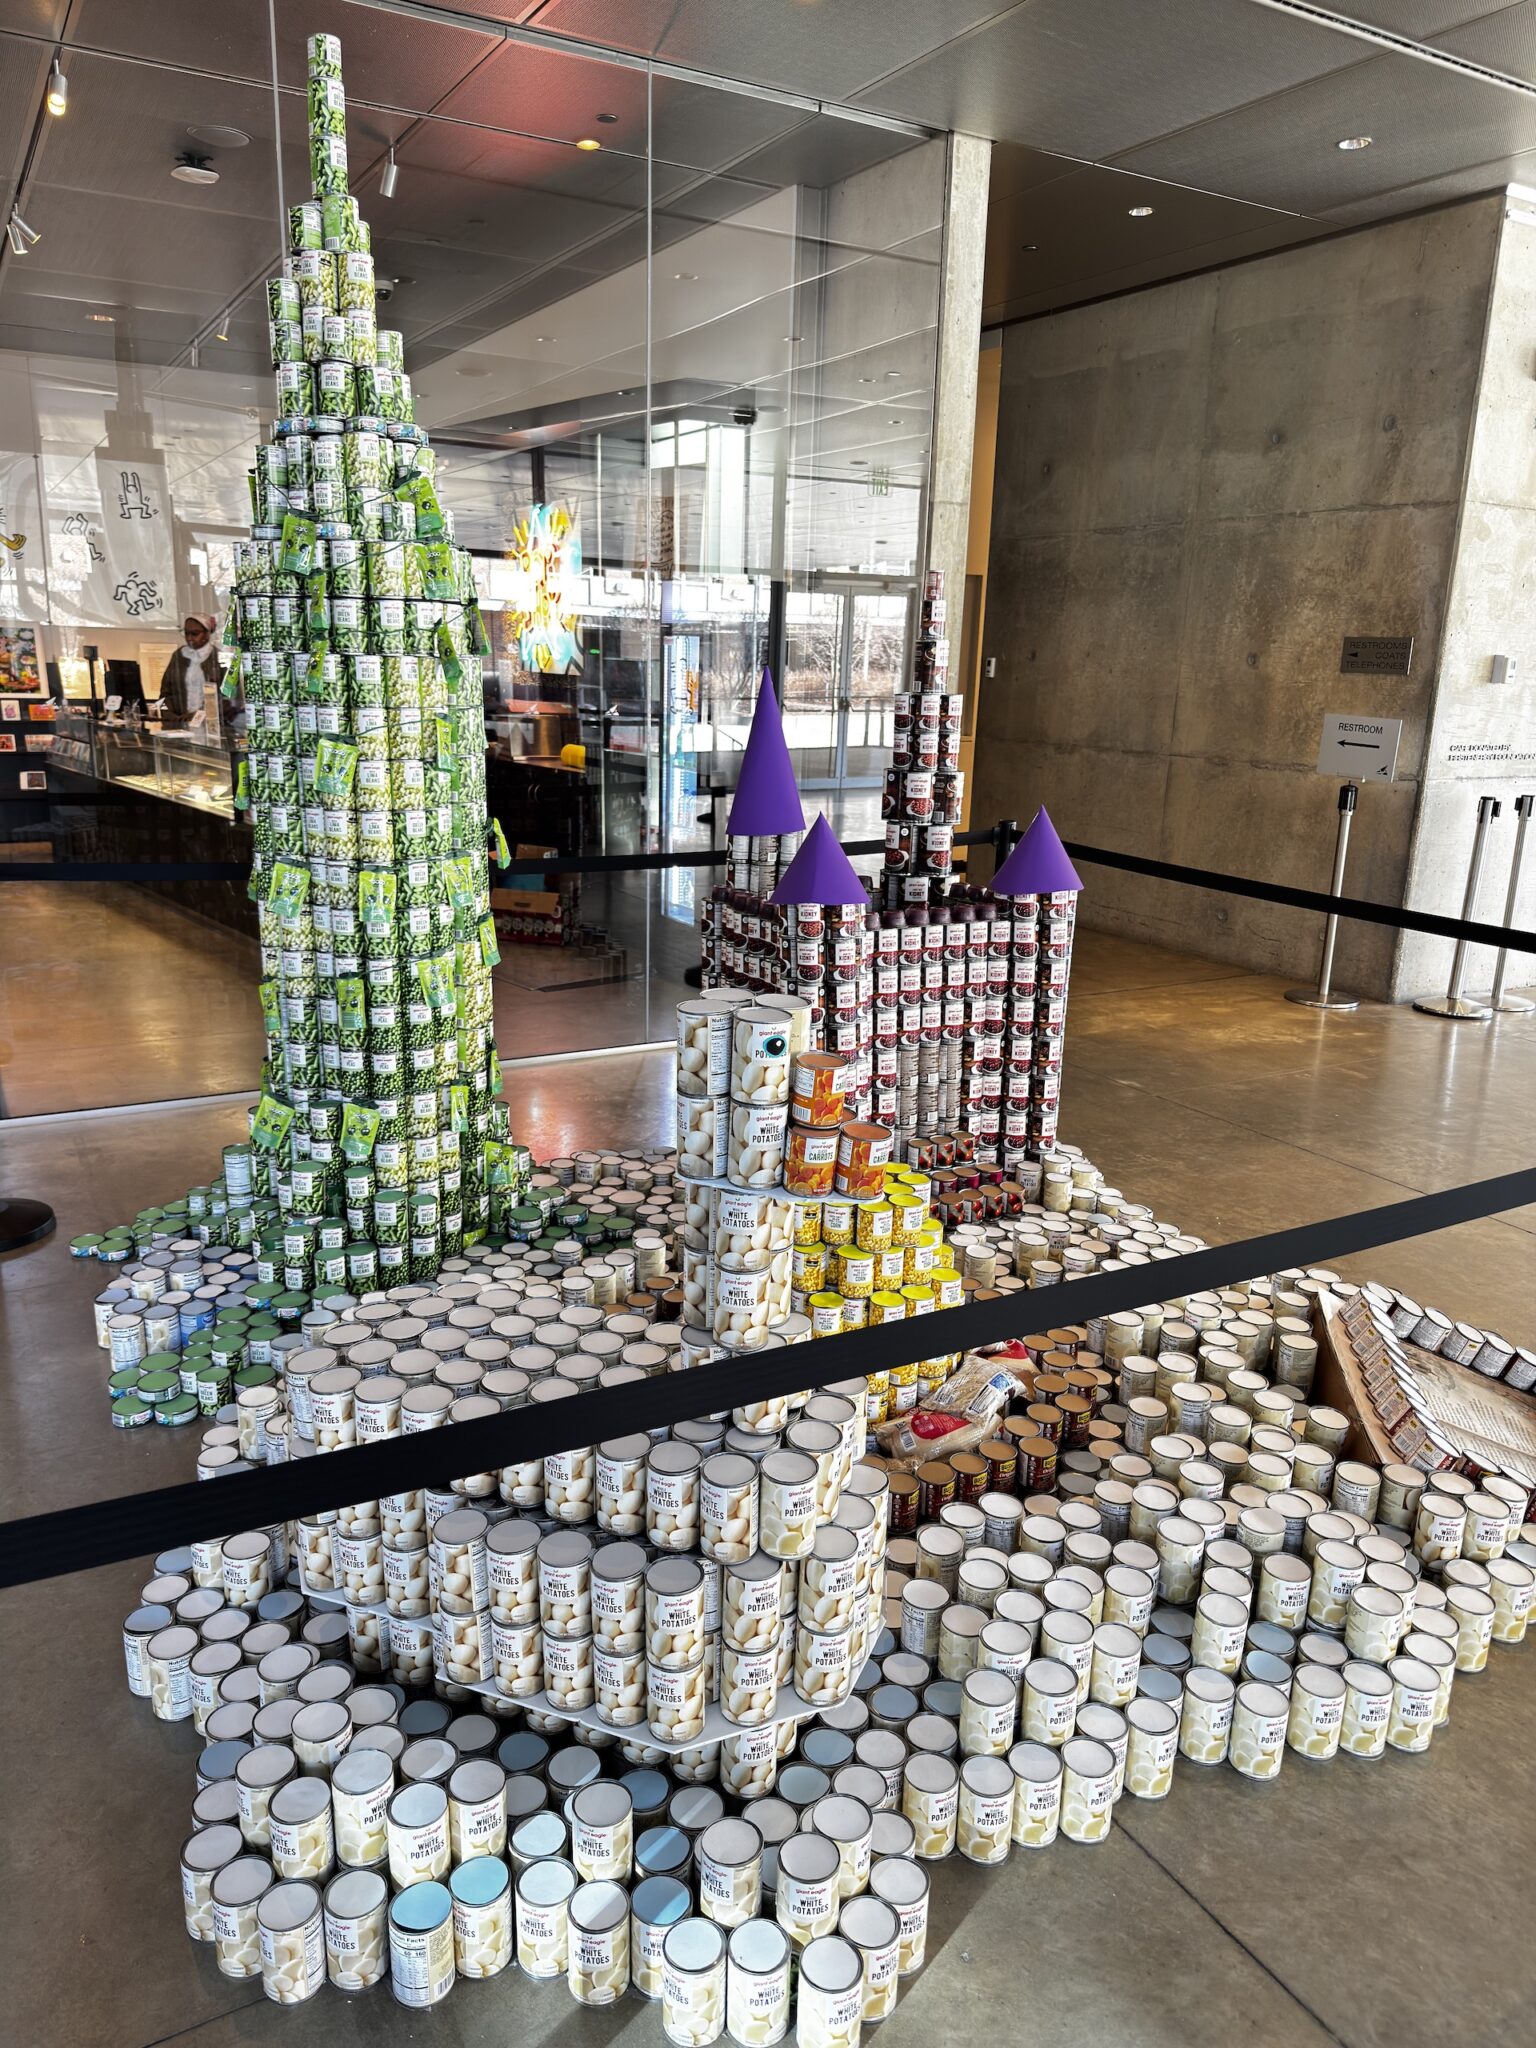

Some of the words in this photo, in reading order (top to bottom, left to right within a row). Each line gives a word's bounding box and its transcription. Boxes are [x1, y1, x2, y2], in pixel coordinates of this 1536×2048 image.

[1338, 723, 1383, 734] RESTROOM
[760, 1126, 779, 1134] WHITE
[752, 1133, 783, 1143] POTATOES
[809, 1153, 833, 1161] CARROTS
[722, 1219, 754, 1228] POTATOES
[728, 1290, 748, 1298] WHITE
[722, 1297, 754, 1306] POTATOES
[315, 1408, 332, 1417] WHITE
[360, 1416, 377, 1426] WHITE
[547, 1462, 562, 1472] WHITE
[654, 1491, 672, 1499] WHITE
[650, 1496, 679, 1507] POTATOES
[793, 1499, 812, 1509] WHITE
[785, 1504, 815, 1516] POTATOES
[1477, 1533, 1504, 1543] POTATOES
[342, 1552, 358, 1561] WHITE
[385, 1562, 400, 1572] WHITE
[226, 1569, 241, 1578] WHITE
[493, 1569, 512, 1577] WHITE
[489, 1574, 519, 1585] POTATOES
[548, 1582, 568, 1591] WHITE
[543, 1588, 575, 1598] POTATOES
[1288, 1593, 1304, 1602] WHITE
[596, 1596, 615, 1605] WHITE
[755, 1595, 775, 1605] WHITE
[748, 1600, 778, 1612] POTATOES
[661, 1617, 696, 1627] POTATOES
[394, 1634, 410, 1643] WHITE
[495, 1642, 512, 1651] WHITE
[550, 1656, 568, 1664] WHITE
[815, 1655, 847, 1666] POTATOES
[823, 1651, 842, 1660] WHITE
[597, 1669, 613, 1678] WHITE
[748, 1670, 769, 1679] WHITE
[741, 1675, 773, 1686] POTATOES
[651, 1689, 682, 1702] POTATOES
[656, 1686, 674, 1695] WHITE
[1057, 1707, 1074, 1718] WHITE
[1369, 1707, 1386, 1716] WHITE
[1402, 1707, 1432, 1717] POTATOES
[1410, 1703, 1429, 1713] WHITE
[1323, 1710, 1340, 1719] WHITE
[1361, 1712, 1390, 1721] POTATOES
[750, 1744, 770, 1753] WHITE
[743, 1748, 774, 1760] POTATOES
[1029, 1800, 1059, 1810] POTATOES
[1037, 1795, 1055, 1805] WHITE
[485, 1802, 500, 1811] eagle
[476, 1812, 497, 1827] WHITE
[977, 1815, 1008, 1825] POTATOES
[985, 1811, 1003, 1820] WHITE
[427, 1825, 442, 1835] eagle
[469, 1816, 502, 1835] POTATOES
[417, 1836, 440, 1851] WHITE
[581, 1840, 603, 1850] WHITE
[410, 1840, 445, 1860] POTATOES
[577, 1845, 610, 1857] POTATOES
[705, 1873, 723, 1889] WHITE
[800, 1899, 823, 1908] WHITE
[792, 1903, 829, 1915] POTATOES
[525, 1920, 546, 1930] WHITE
[902, 1914, 921, 1927] WHITE
[329, 1929, 347, 1942] WHITE
[521, 1924, 553, 1937] POTATOES
[580, 1949, 602, 1958] WHITE
[575, 1953, 610, 1965] POTATOES
[768, 1974, 783, 1983] eagle
[665, 1978, 681, 1992] WHITE
[750, 1989, 785, 2006] POTATOES
[758, 1988, 779, 2000] WHITE
[837, 2001, 857, 2016] WHITE
